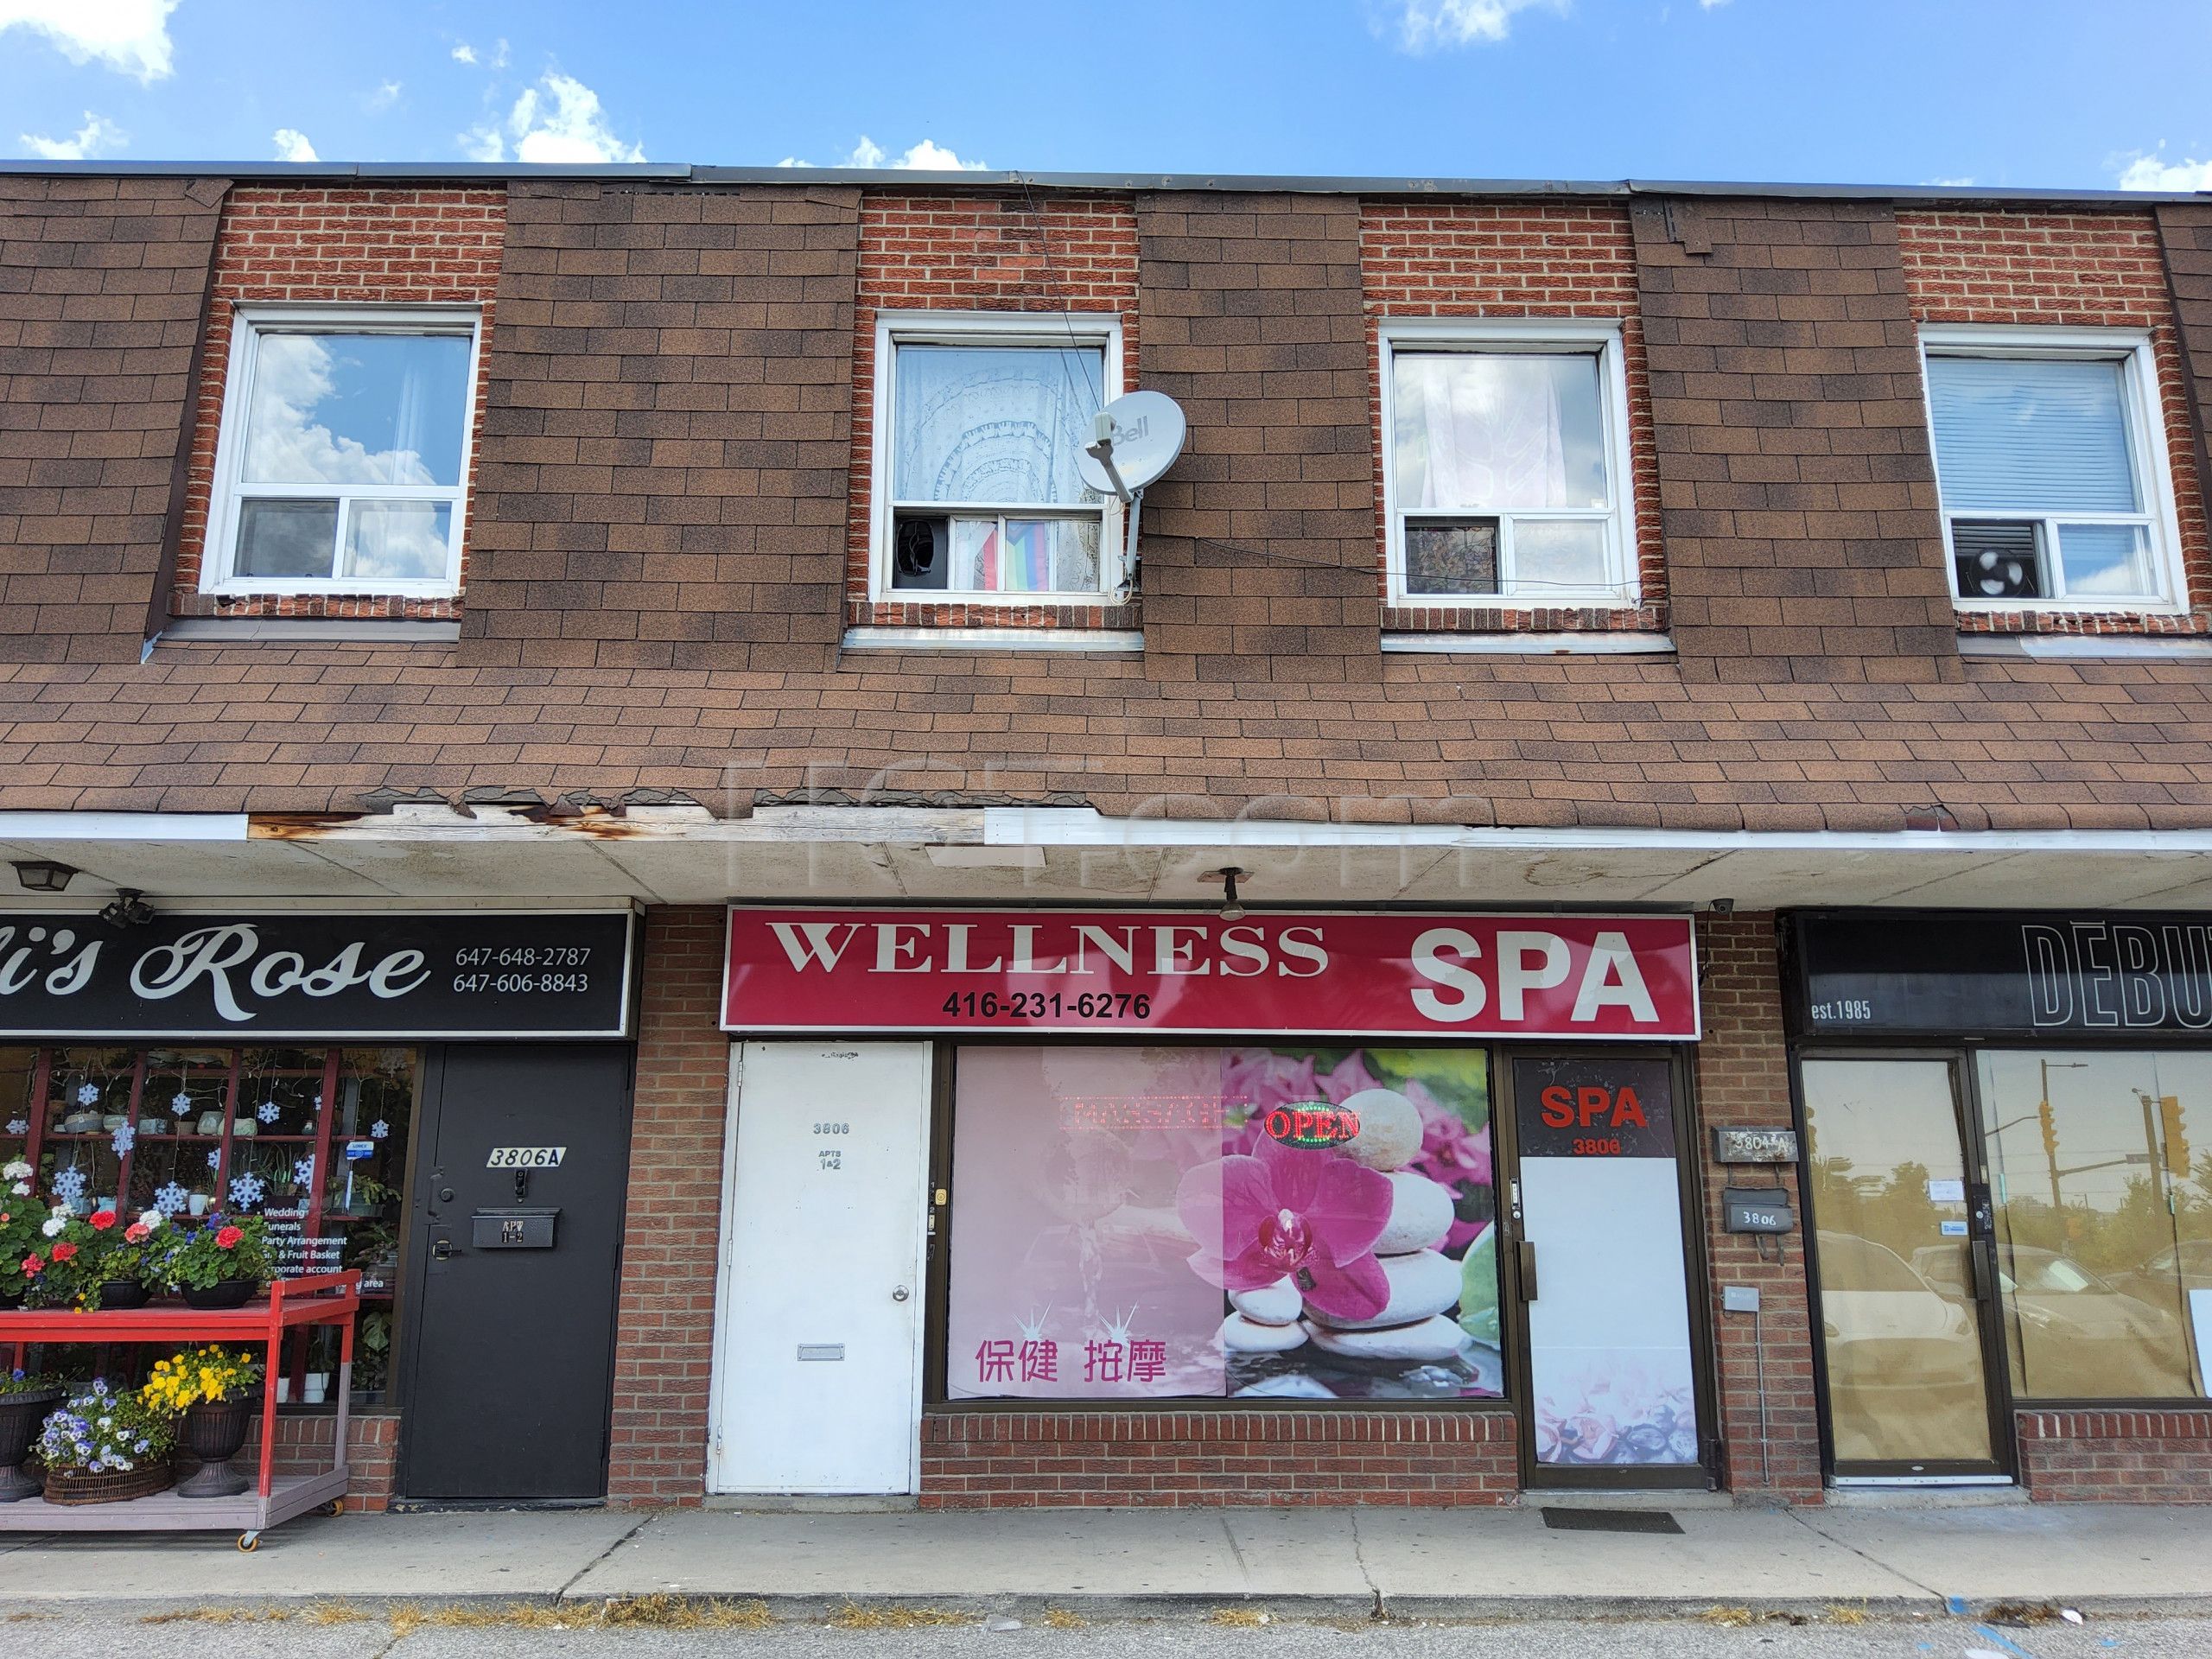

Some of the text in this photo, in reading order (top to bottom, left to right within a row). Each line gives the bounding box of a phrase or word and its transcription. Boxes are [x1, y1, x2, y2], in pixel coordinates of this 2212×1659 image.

[1111, 415, 1149, 446] Bell
[455, 947, 591, 967] 647-648-2787
[130, 923, 431, 1022] Rose
[766, 922, 1661, 1023] WELLNESS SPA
[453, 973, 588, 993] 647-606-8843
[942, 991, 1151, 1020] 416-231-6276
[1541, 1085, 1649, 1128] SPA
[813, 1122, 849, 1135] 3806
[1266, 1110, 1360, 1139] OPEN
[1573, 1138, 1621, 1154] 3806
[490, 1148, 560, 1166] 3806A
[264, 1208, 305, 1218] Wedding
[1743, 1211, 1777, 1225] 3806
[262, 1236, 347, 1247] Party Arrangement
[503, 1231, 523, 1243] 1-2
[278, 1250, 286, 1259] &
[288, 1250, 308, 1259] Fruit
[310, 1250, 340, 1259] Basket
[975, 1339, 1167, 1382] 保健 按摩
